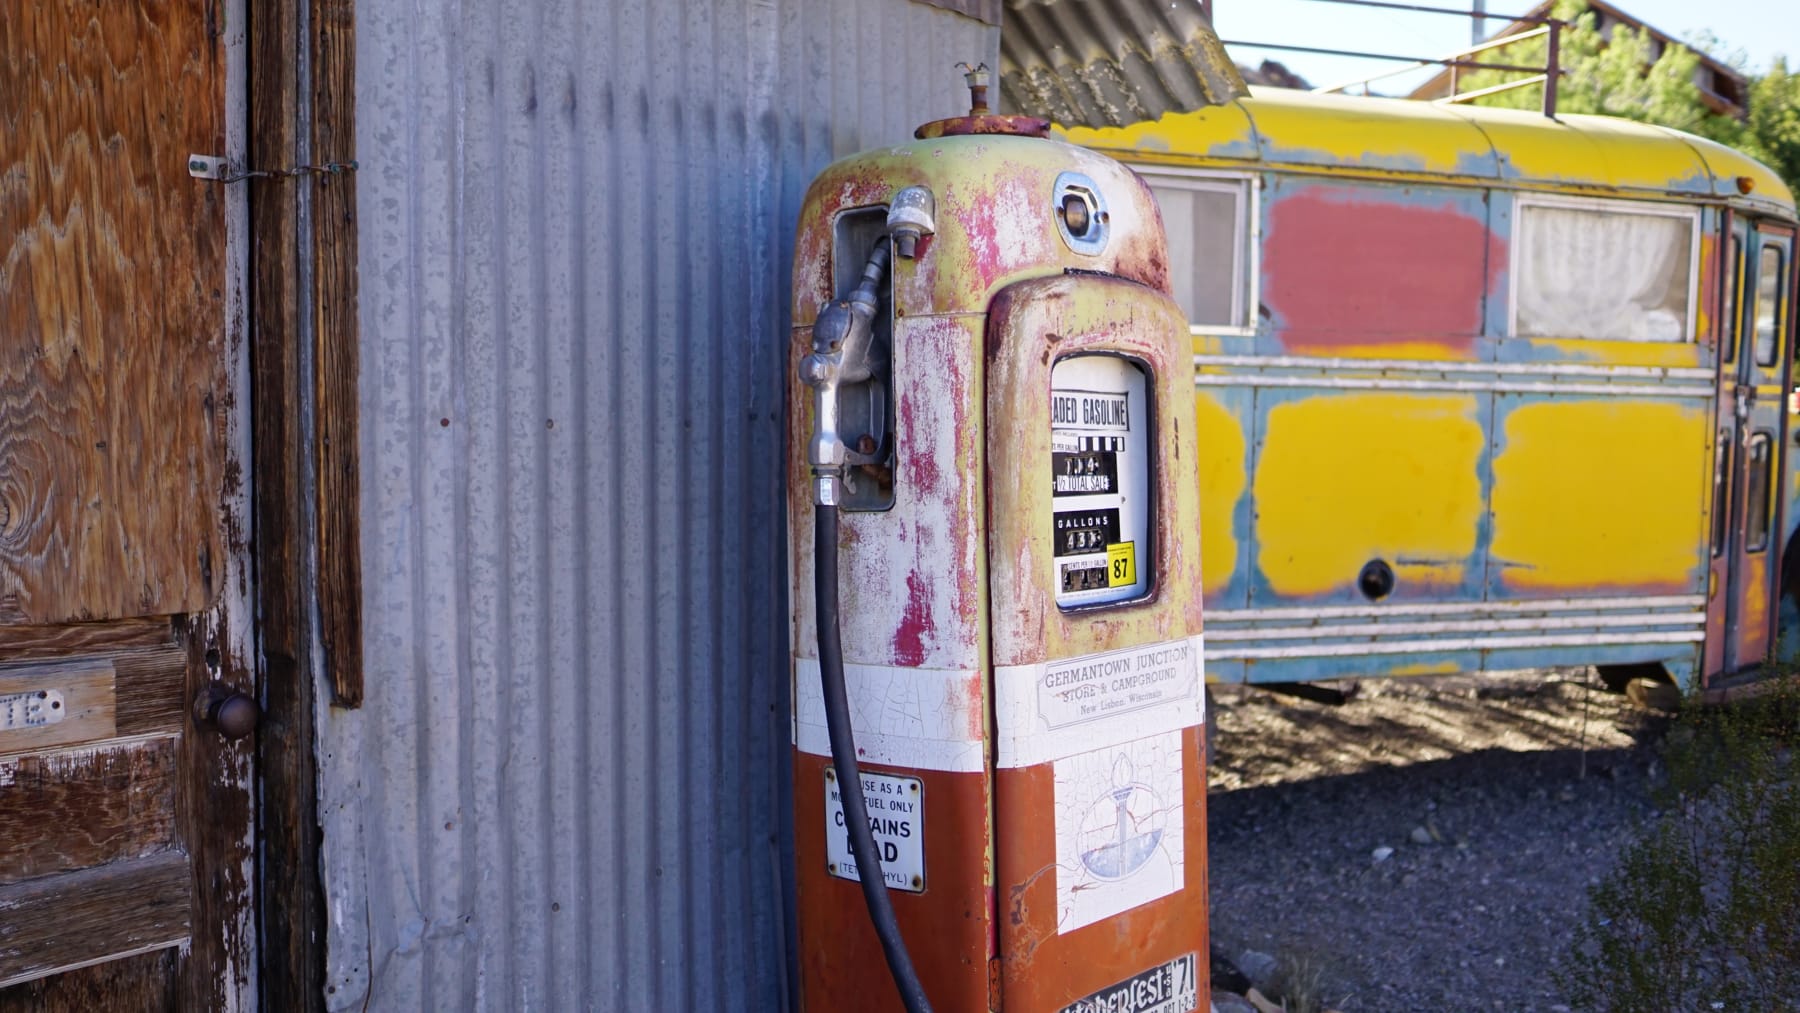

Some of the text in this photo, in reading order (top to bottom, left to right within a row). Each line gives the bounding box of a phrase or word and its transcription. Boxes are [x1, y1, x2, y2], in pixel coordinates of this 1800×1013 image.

[1051, 396, 1126, 426] ADED GASOLINE
[1068, 475, 1089, 490] TOTAL
[1058, 516, 1109, 529] GALLONS
[1113, 558, 1128, 579] 87
[1045, 646, 1188, 689] GERMANTOWN JUNCTION
[1062, 667, 1177, 703] STORE & CAMPGROUND
[1080, 704, 1097, 715] New
[880, 783, 892, 794] AS
[896, 784, 903, 796] A
[890, 801, 914, 813] ONLY
